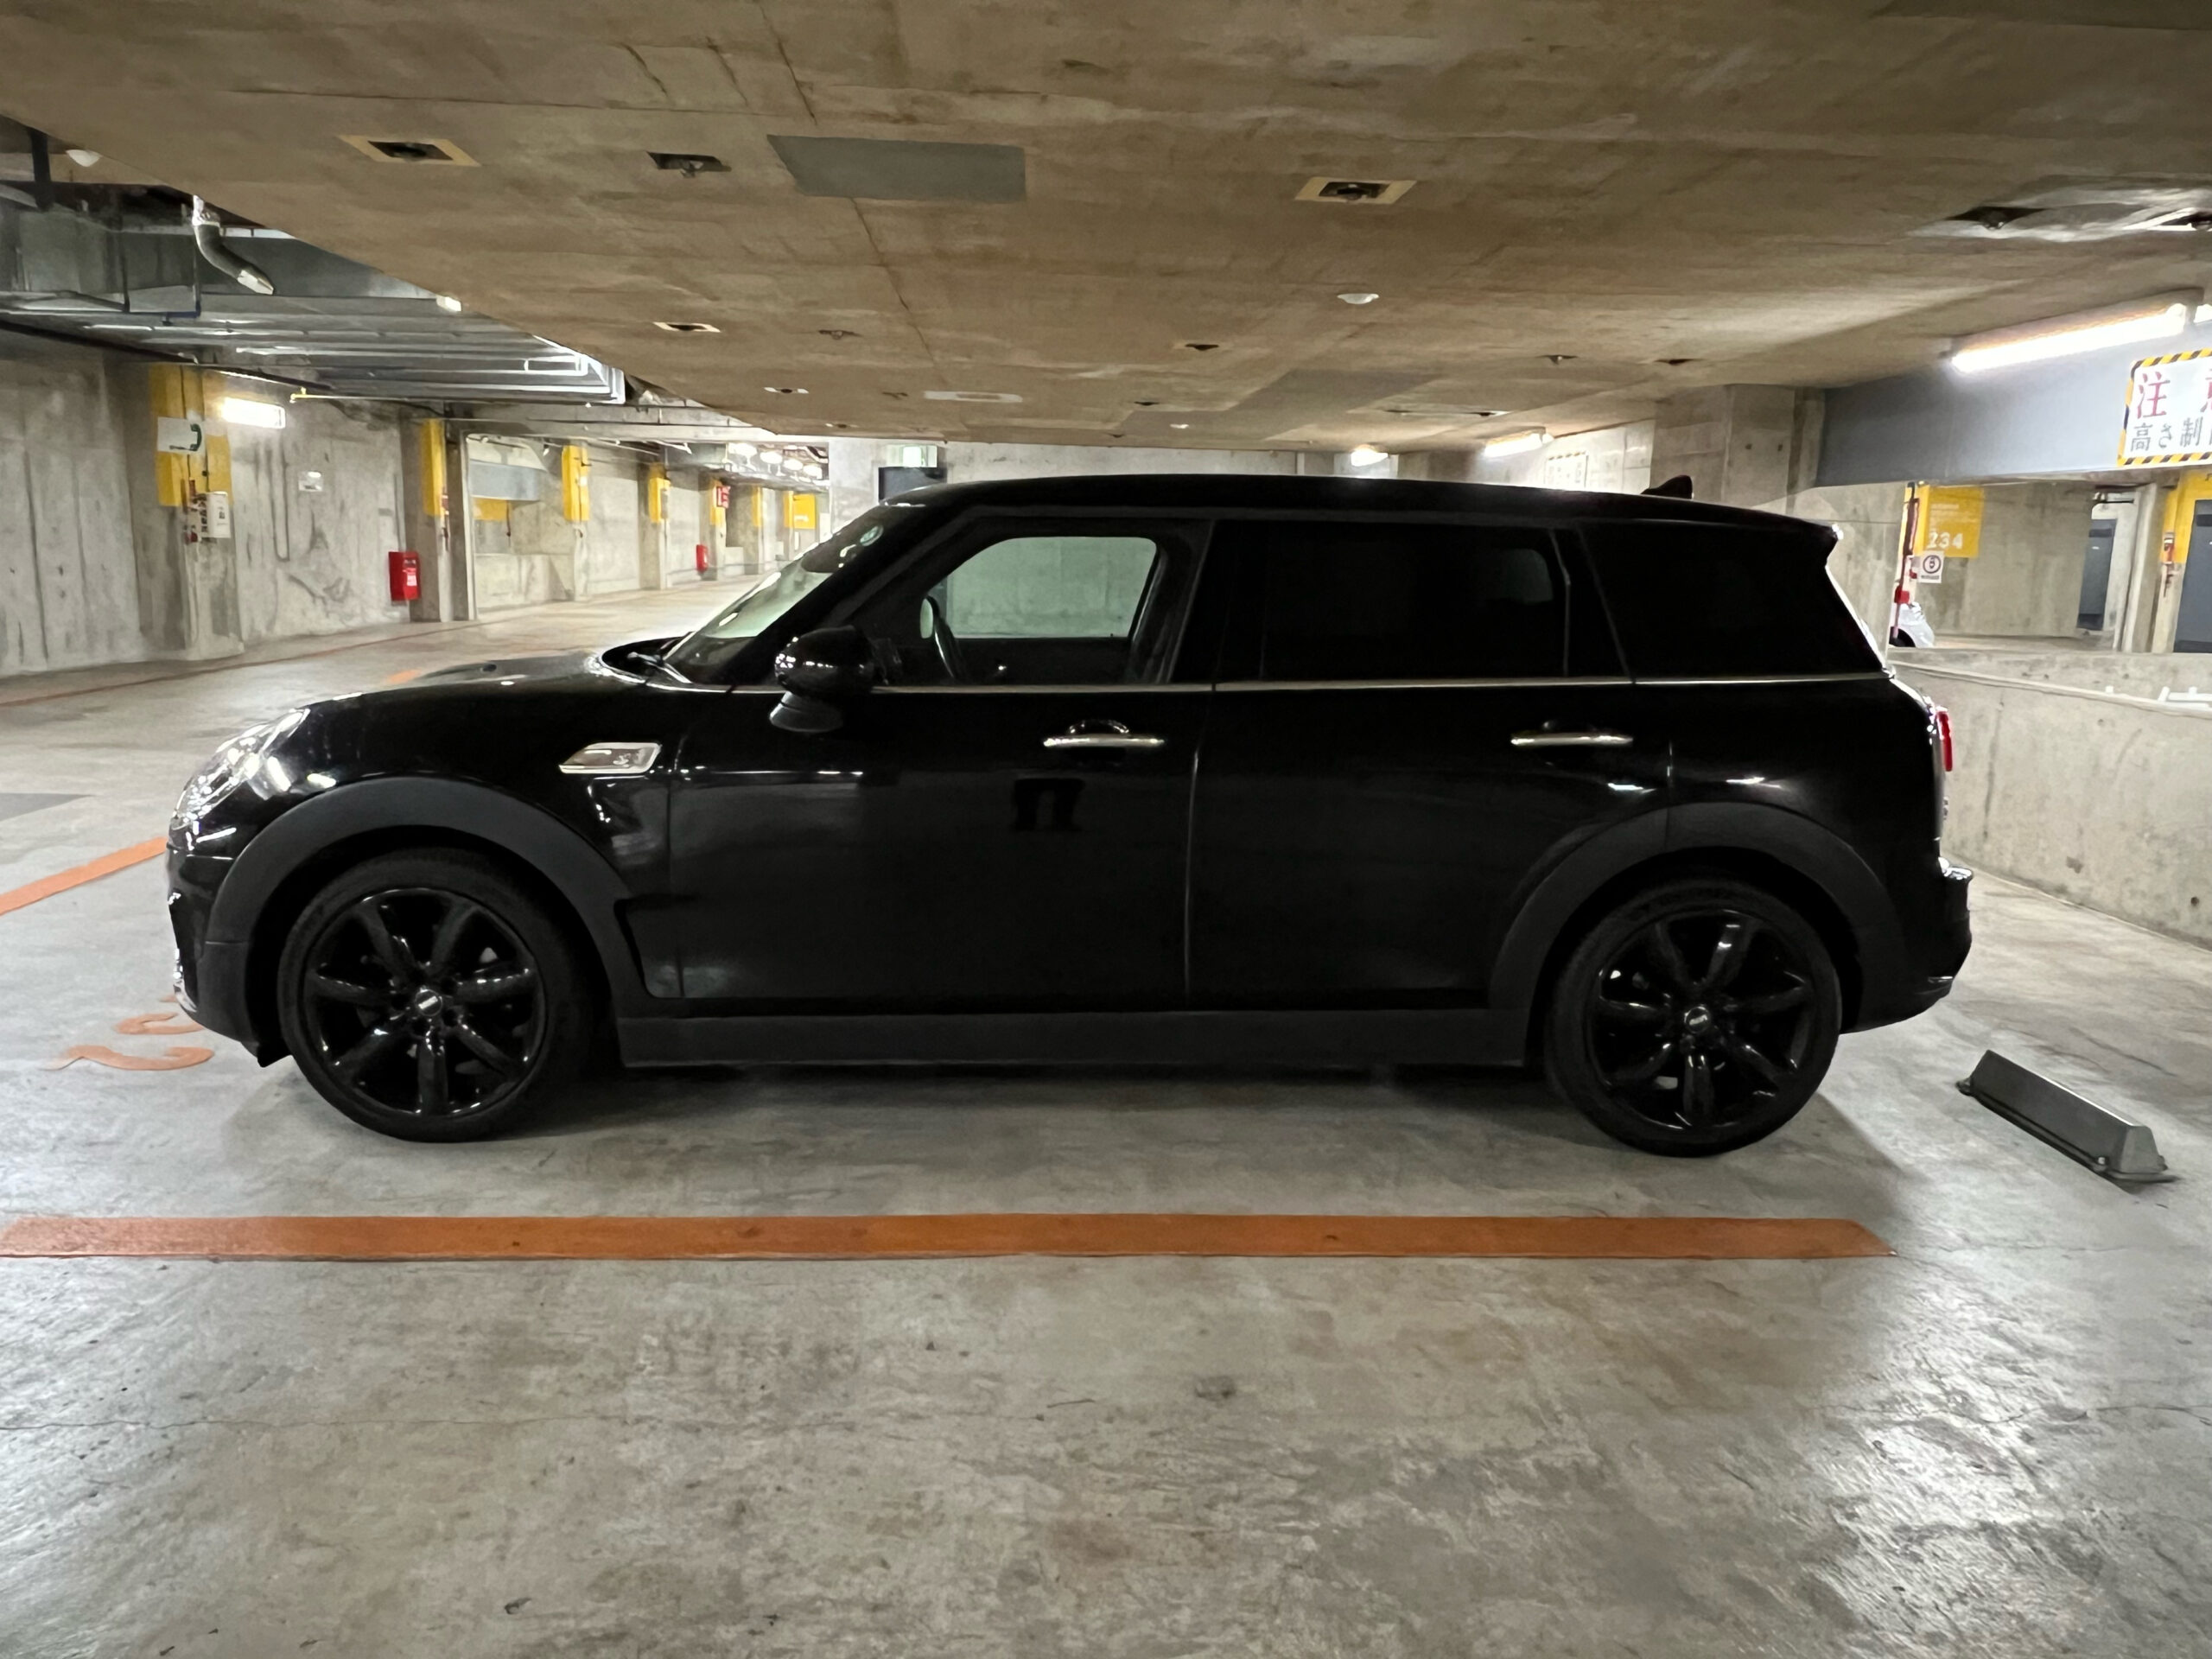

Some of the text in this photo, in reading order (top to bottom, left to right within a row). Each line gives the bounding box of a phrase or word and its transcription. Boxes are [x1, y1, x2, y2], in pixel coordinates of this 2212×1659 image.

[2130, 416, 2212, 452] 高さ制
[1926, 531, 1963, 550] 234
